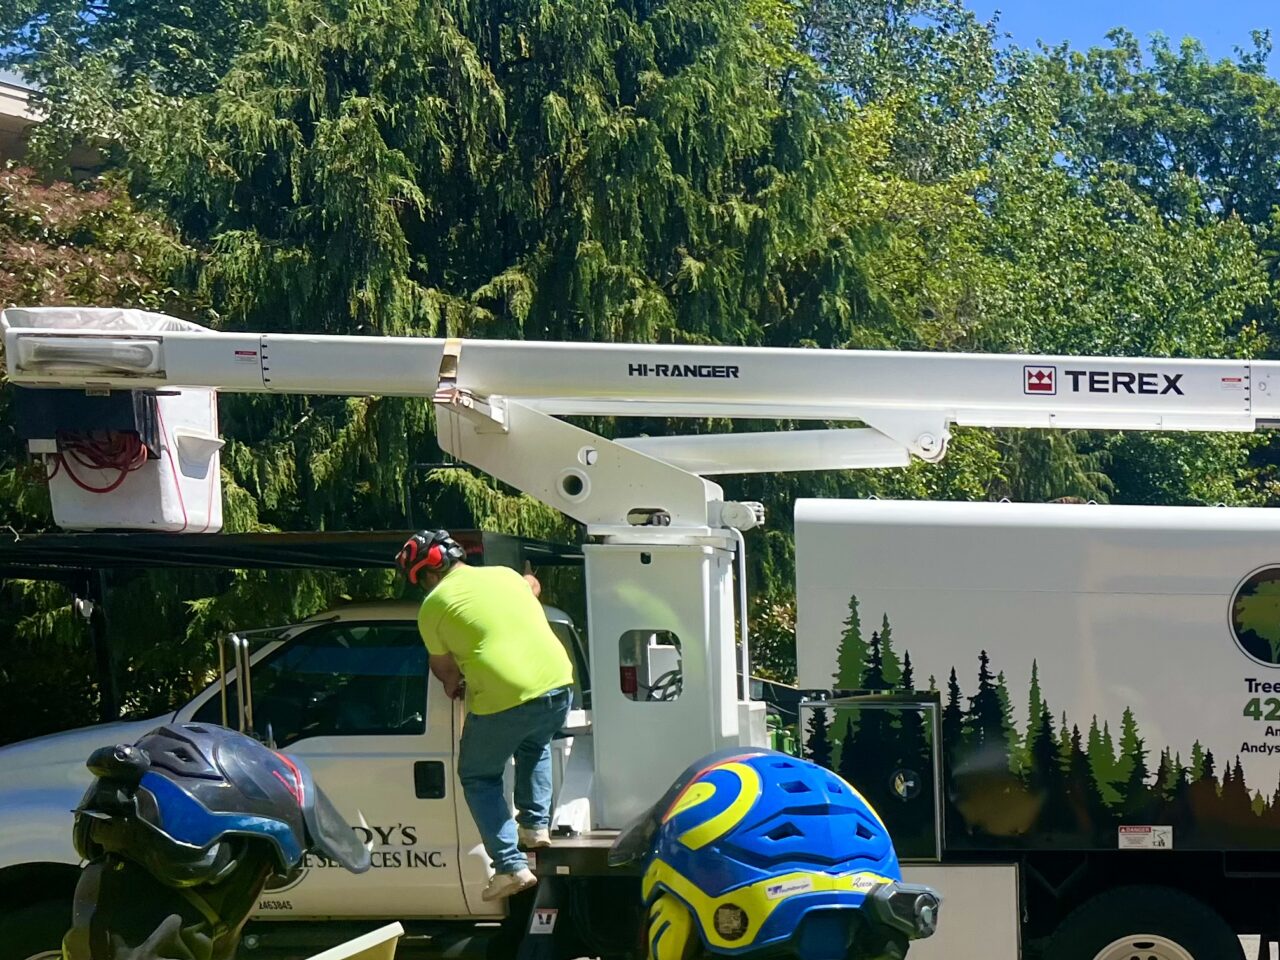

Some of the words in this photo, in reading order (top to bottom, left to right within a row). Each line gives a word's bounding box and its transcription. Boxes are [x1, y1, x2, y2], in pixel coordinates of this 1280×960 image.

[628, 363, 740, 379] HI-RANGER
[1064, 369, 1186, 396] TEREX
[351, 823, 418, 846] DY'S
[406, 850, 447, 868] INC.
